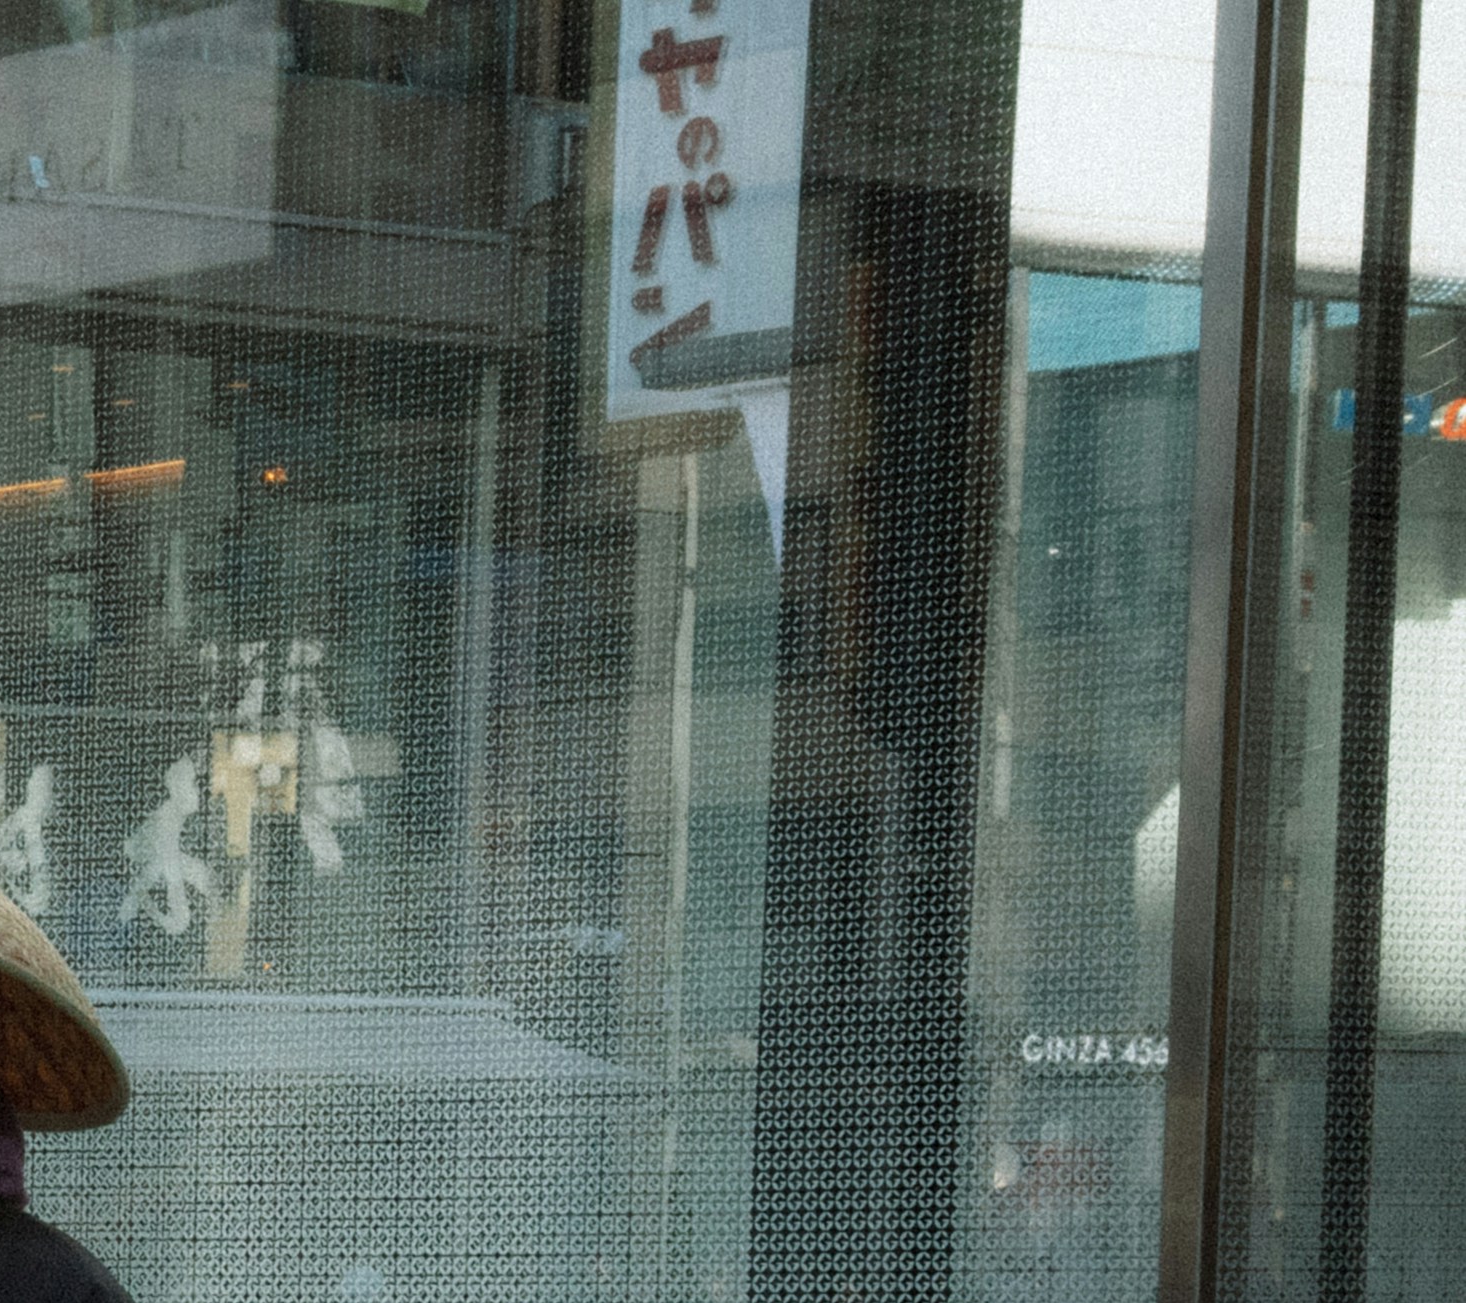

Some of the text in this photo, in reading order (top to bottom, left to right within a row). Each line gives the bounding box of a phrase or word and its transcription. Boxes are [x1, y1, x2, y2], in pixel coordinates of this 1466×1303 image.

[630, 0, 735, 365] ヤのパン
[1021, 1033, 1113, 1063] GINZA
